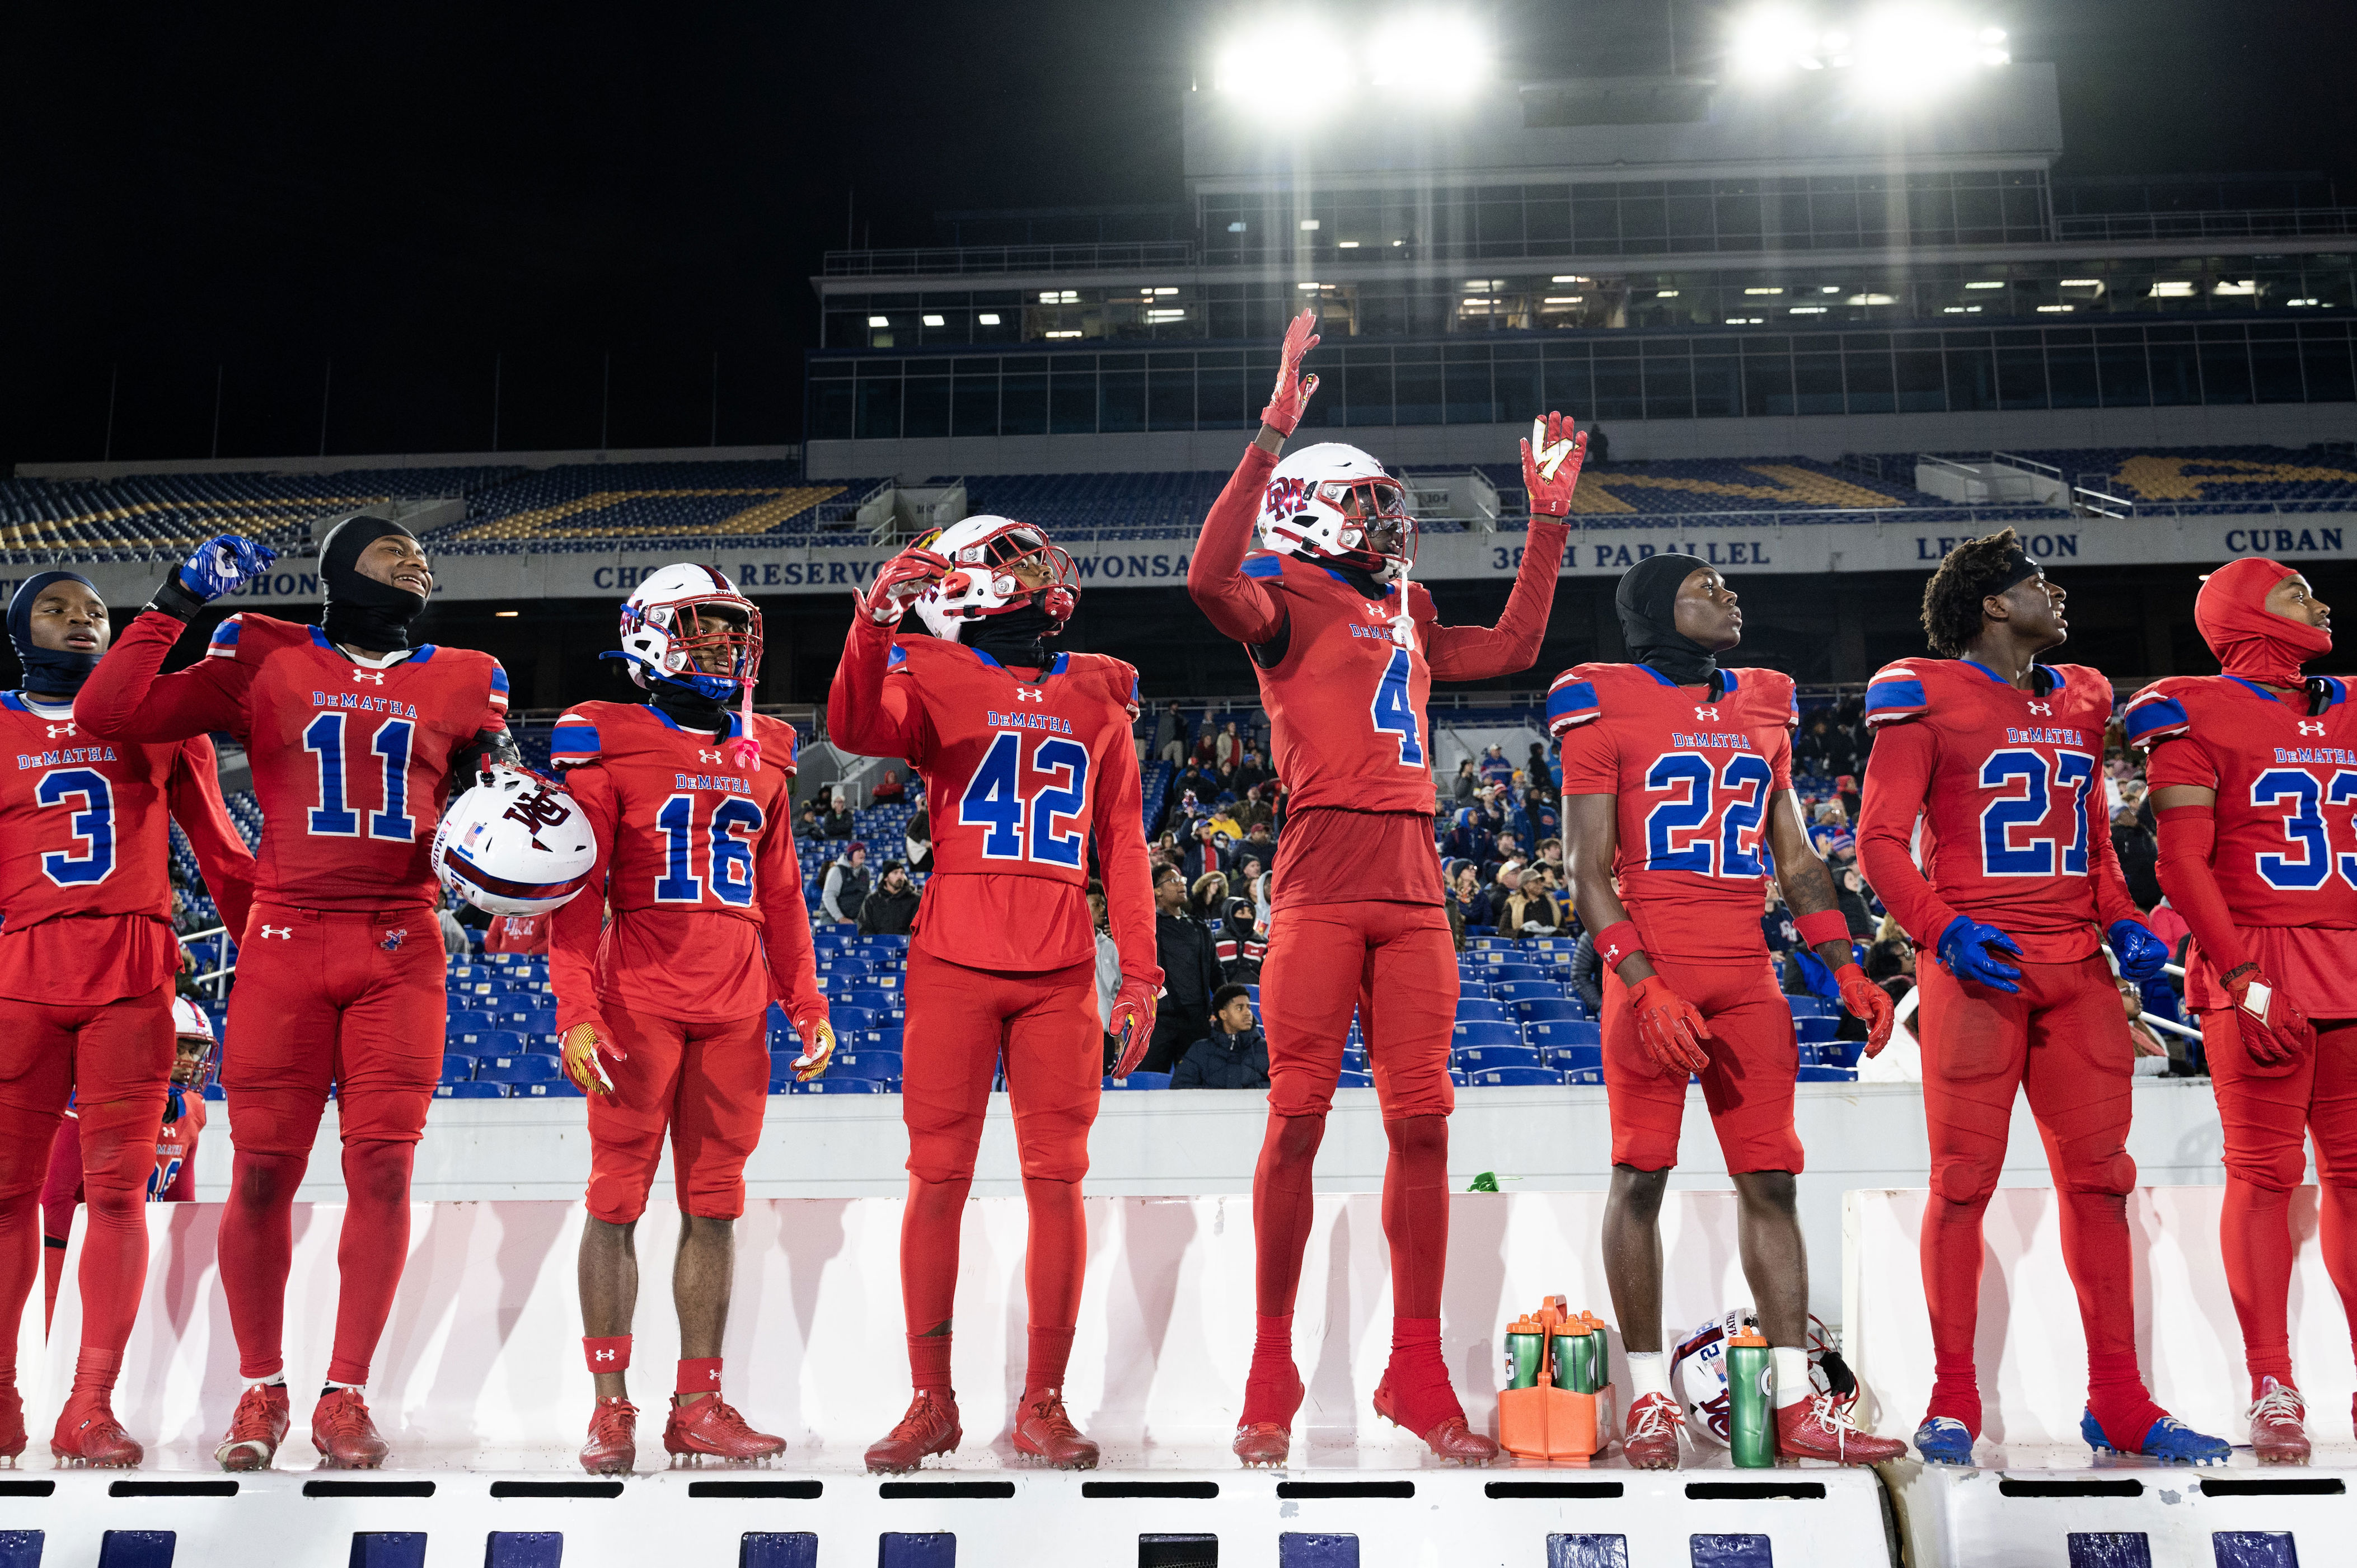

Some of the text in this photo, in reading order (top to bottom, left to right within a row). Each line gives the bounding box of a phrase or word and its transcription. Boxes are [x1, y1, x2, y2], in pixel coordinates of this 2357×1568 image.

[1071, 555, 1191, 578] WONSA
[1492, 540, 1770, 570] 38H PARALLEL
[2225, 528, 2342, 552] CUBAN
[1370, 645, 1425, 768] 4
[34, 767, 116, 887] 3
[302, 711, 416, 843] 11
[958, 731, 1090, 870] 42
[1644, 751, 1773, 879] 22
[1979, 748, 2095, 877] 27
[654, 794, 765, 908] 16
